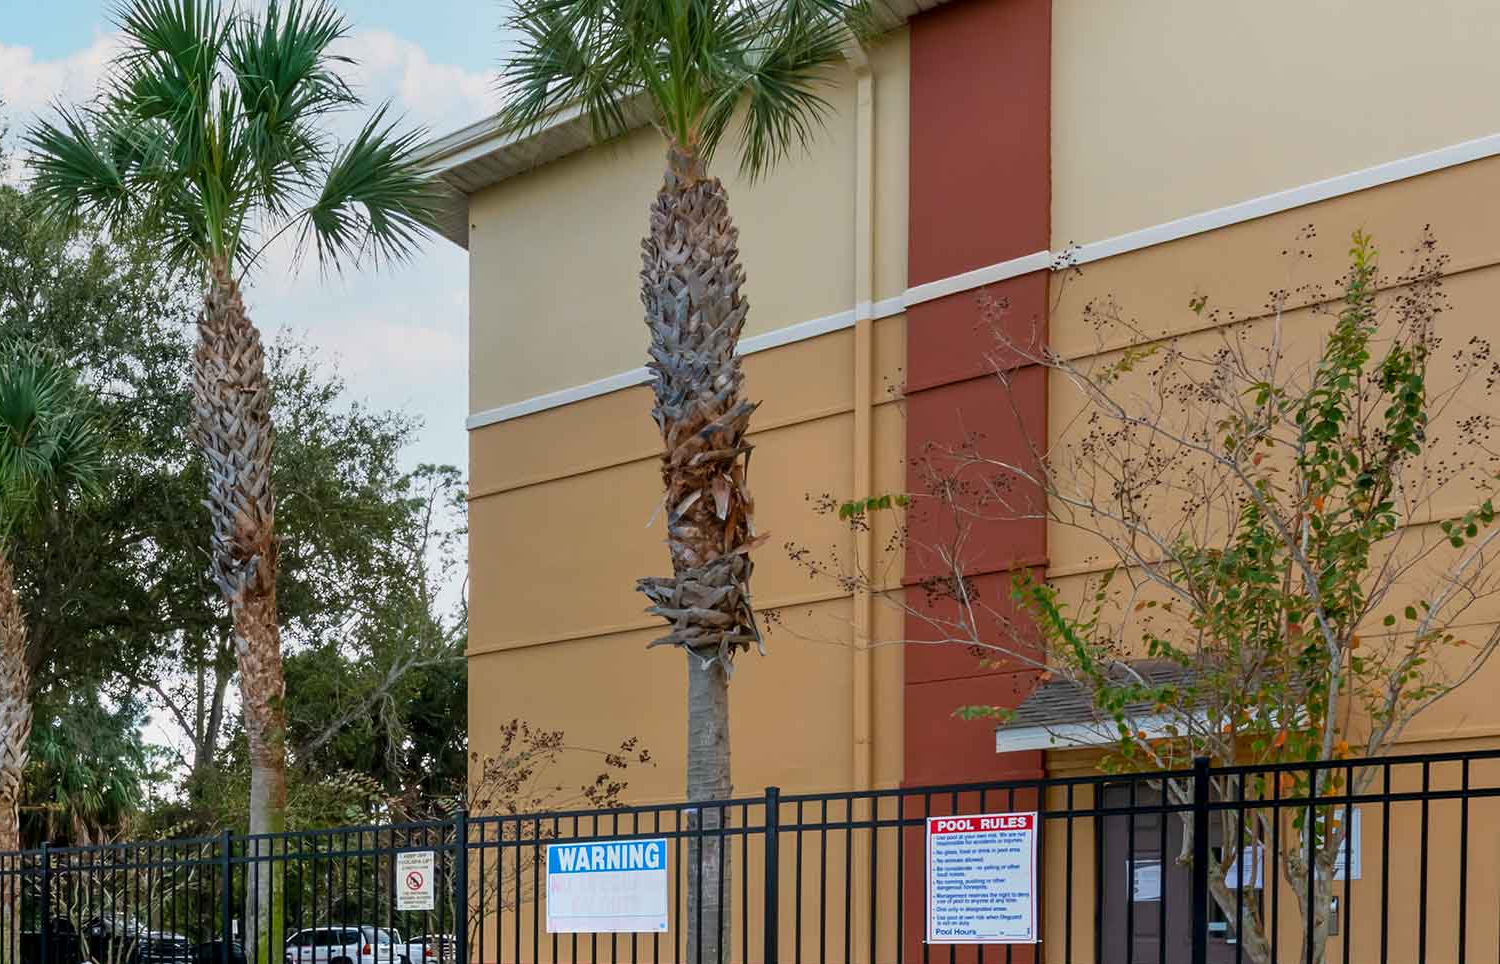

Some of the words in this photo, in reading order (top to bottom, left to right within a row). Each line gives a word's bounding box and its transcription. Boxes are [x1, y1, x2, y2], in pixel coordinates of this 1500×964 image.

[937, 820, 975, 832] POOL
[980, 817, 1027, 830] RULES
[557, 842, 660, 872] WARNING
[954, 928, 977, 936] Hours
